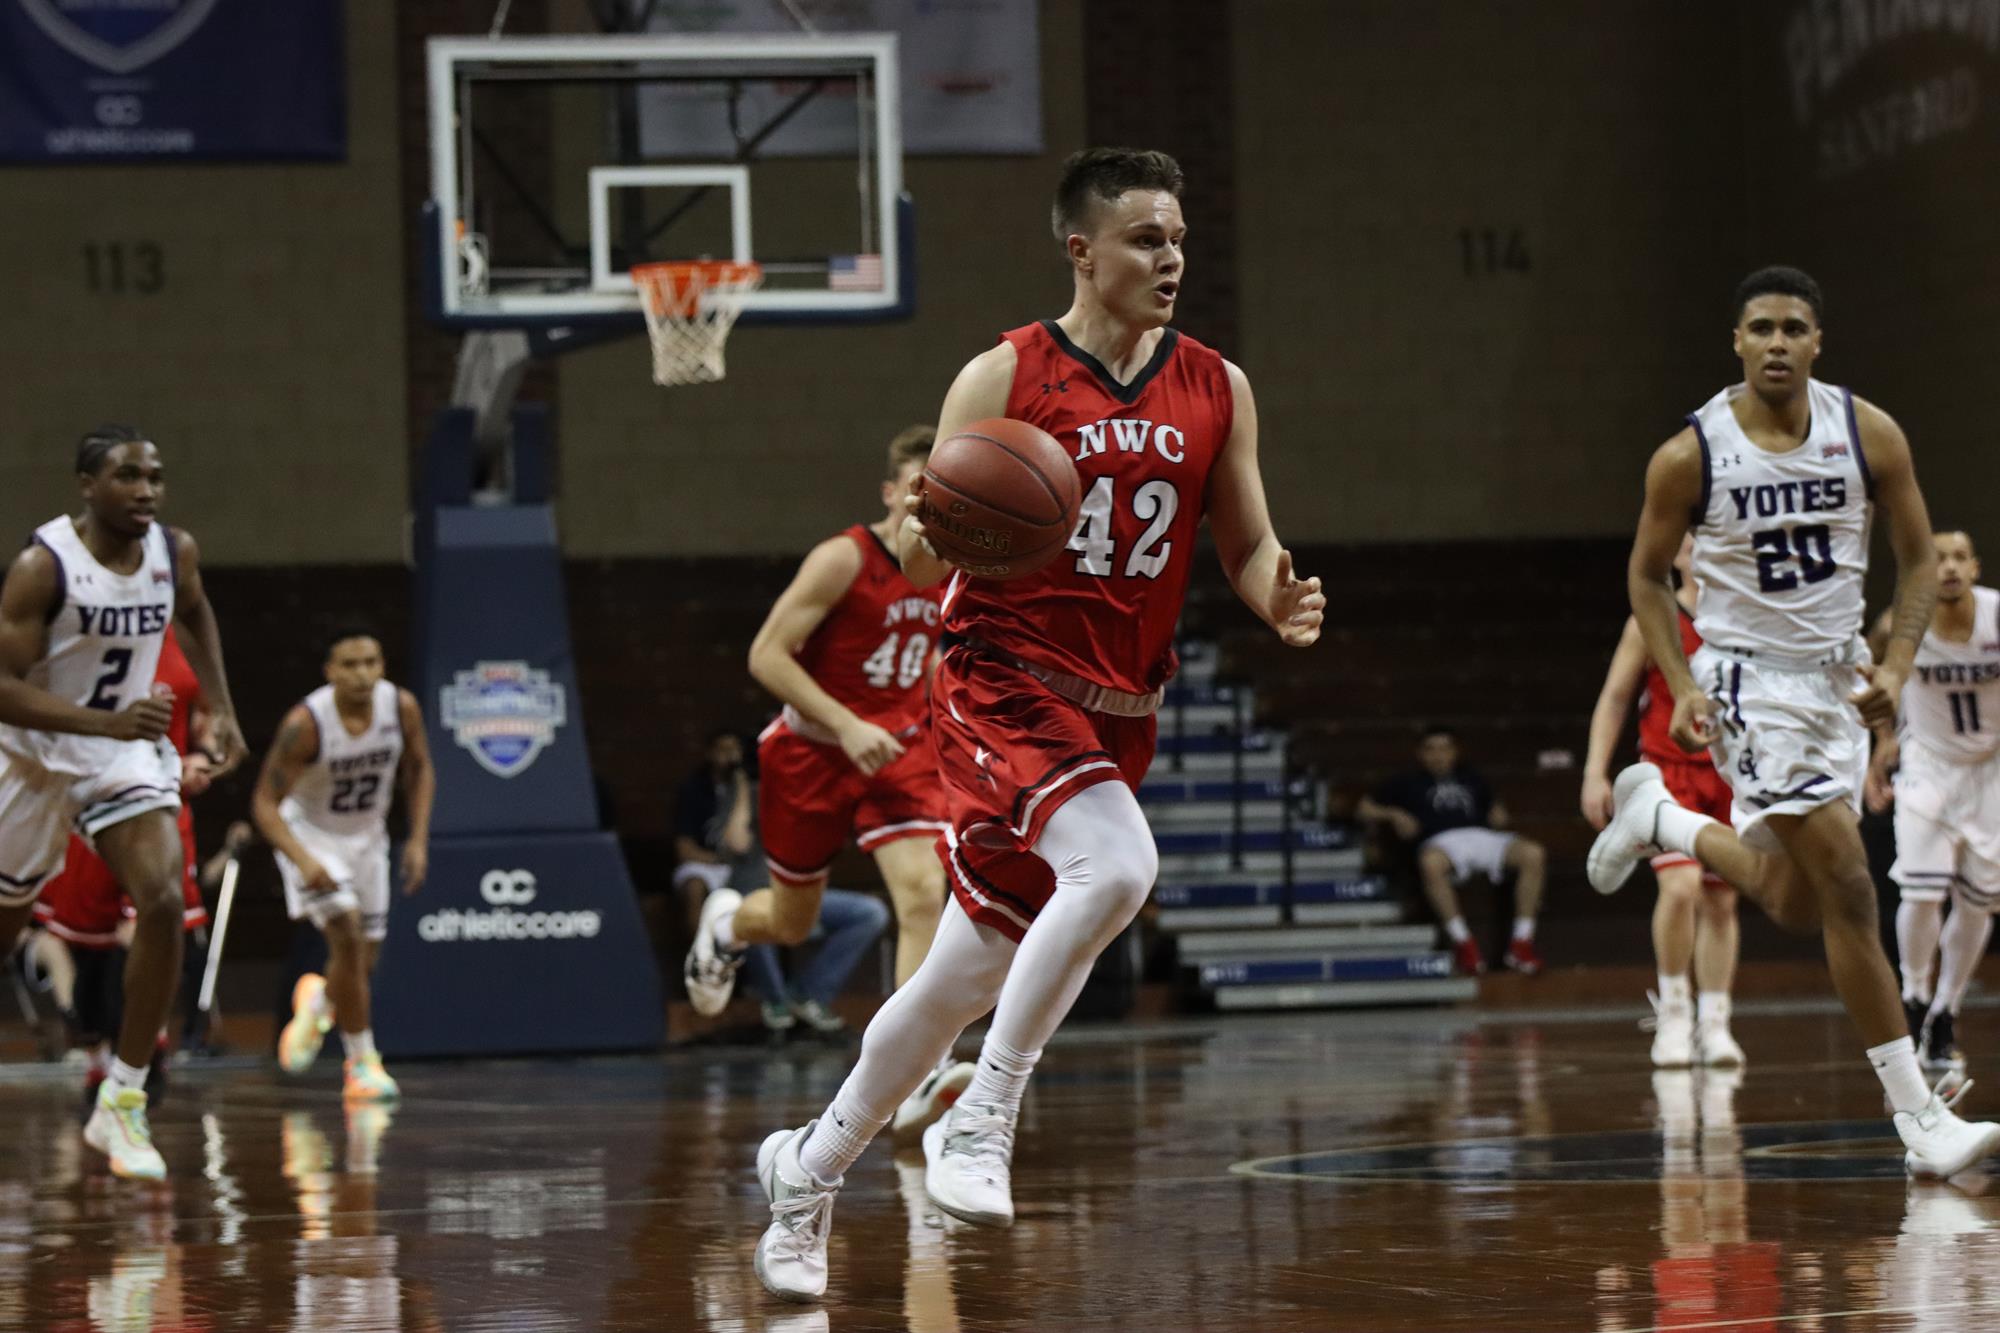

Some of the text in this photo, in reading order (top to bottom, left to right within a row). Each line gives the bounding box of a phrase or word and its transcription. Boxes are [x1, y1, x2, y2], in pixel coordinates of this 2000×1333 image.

[83, 241, 164, 295] 113
[1075, 418, 1185, 464] NWC
[1729, 477, 1846, 520] YOTES
[1064, 476, 1180, 580] 42
[1752, 524, 1837, 593] 20
[77, 603, 167, 637] YOTES
[883, 597, 940, 628] NWC
[86, 647, 133, 712] 2
[862, 631, 929, 689] 40
[1915, 661, 2000, 686] YOTES
[1946, 690, 1982, 736] 11
[329, 774, 381, 814] 22
